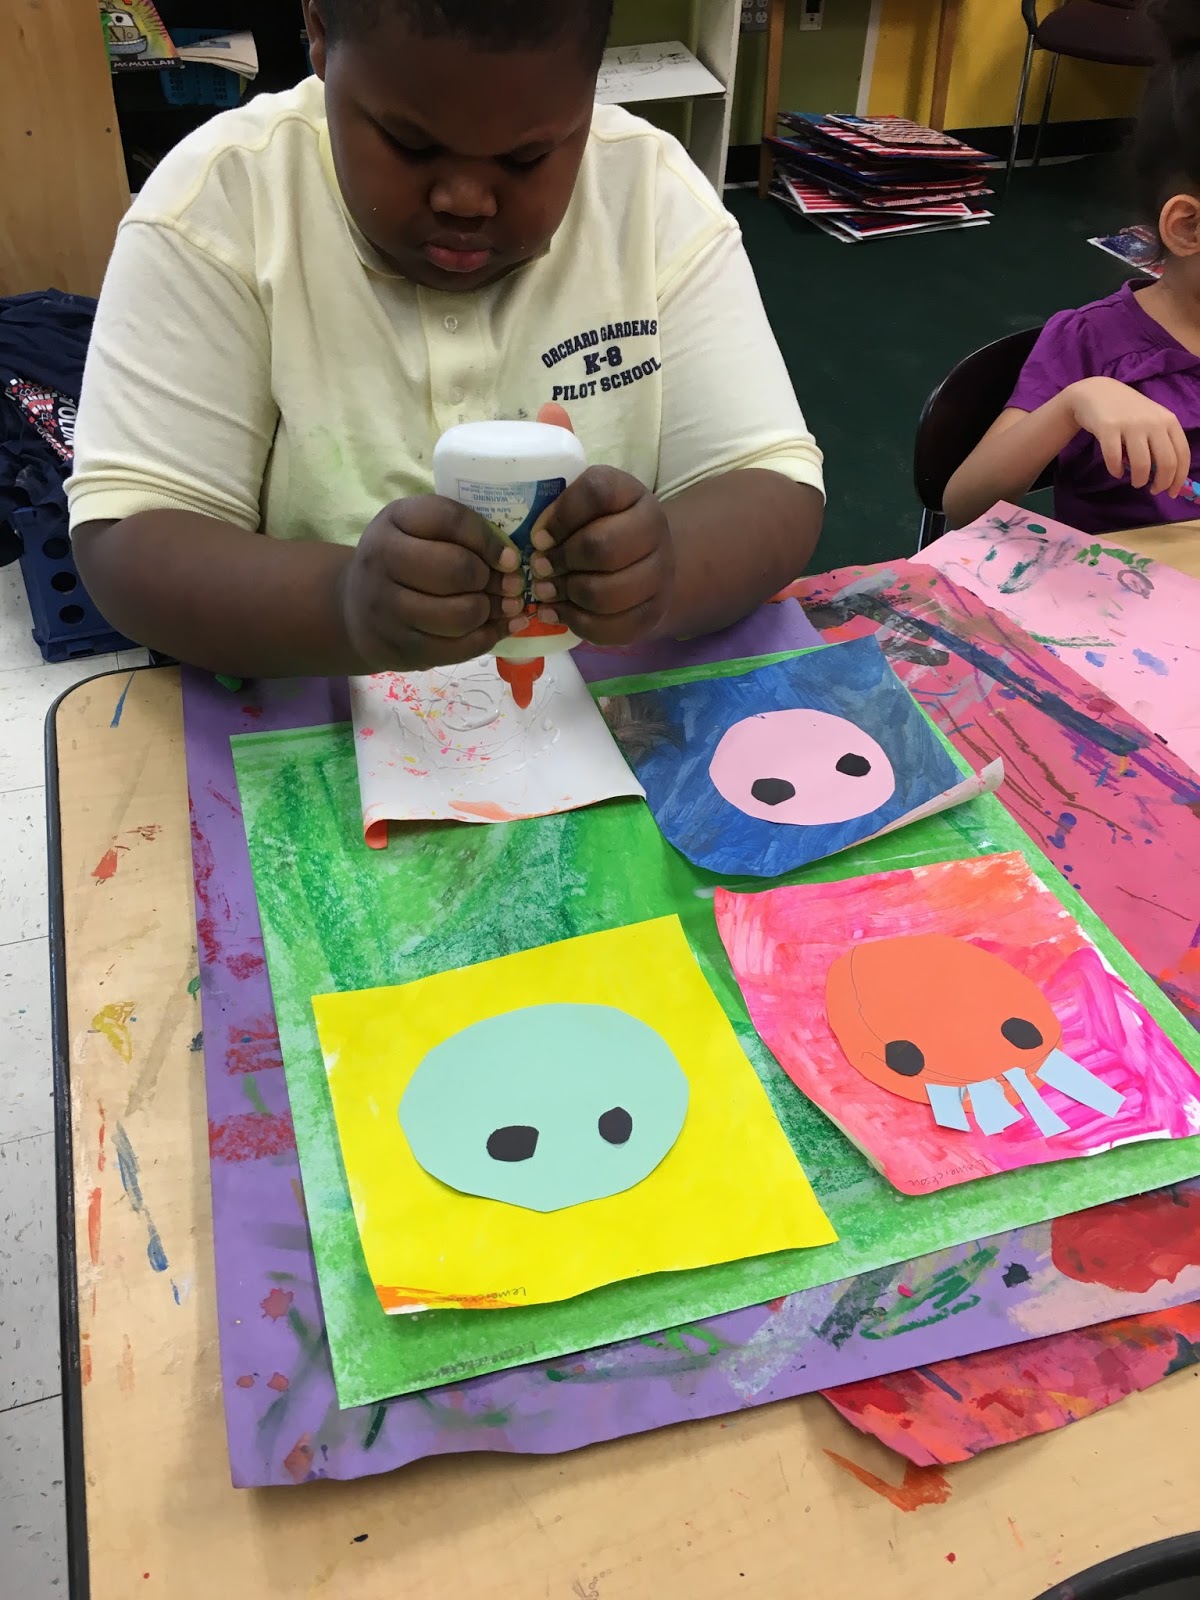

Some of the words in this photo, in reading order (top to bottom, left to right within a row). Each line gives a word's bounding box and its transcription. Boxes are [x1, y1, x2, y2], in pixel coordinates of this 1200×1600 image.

[541, 329, 599, 368] ORCHARD
[600, 319, 658, 342] GARDENS
[583, 345, 623, 375] K-8
[552, 380, 597, 401] PILOT
[600, 357, 662, 392] SCHOOL
